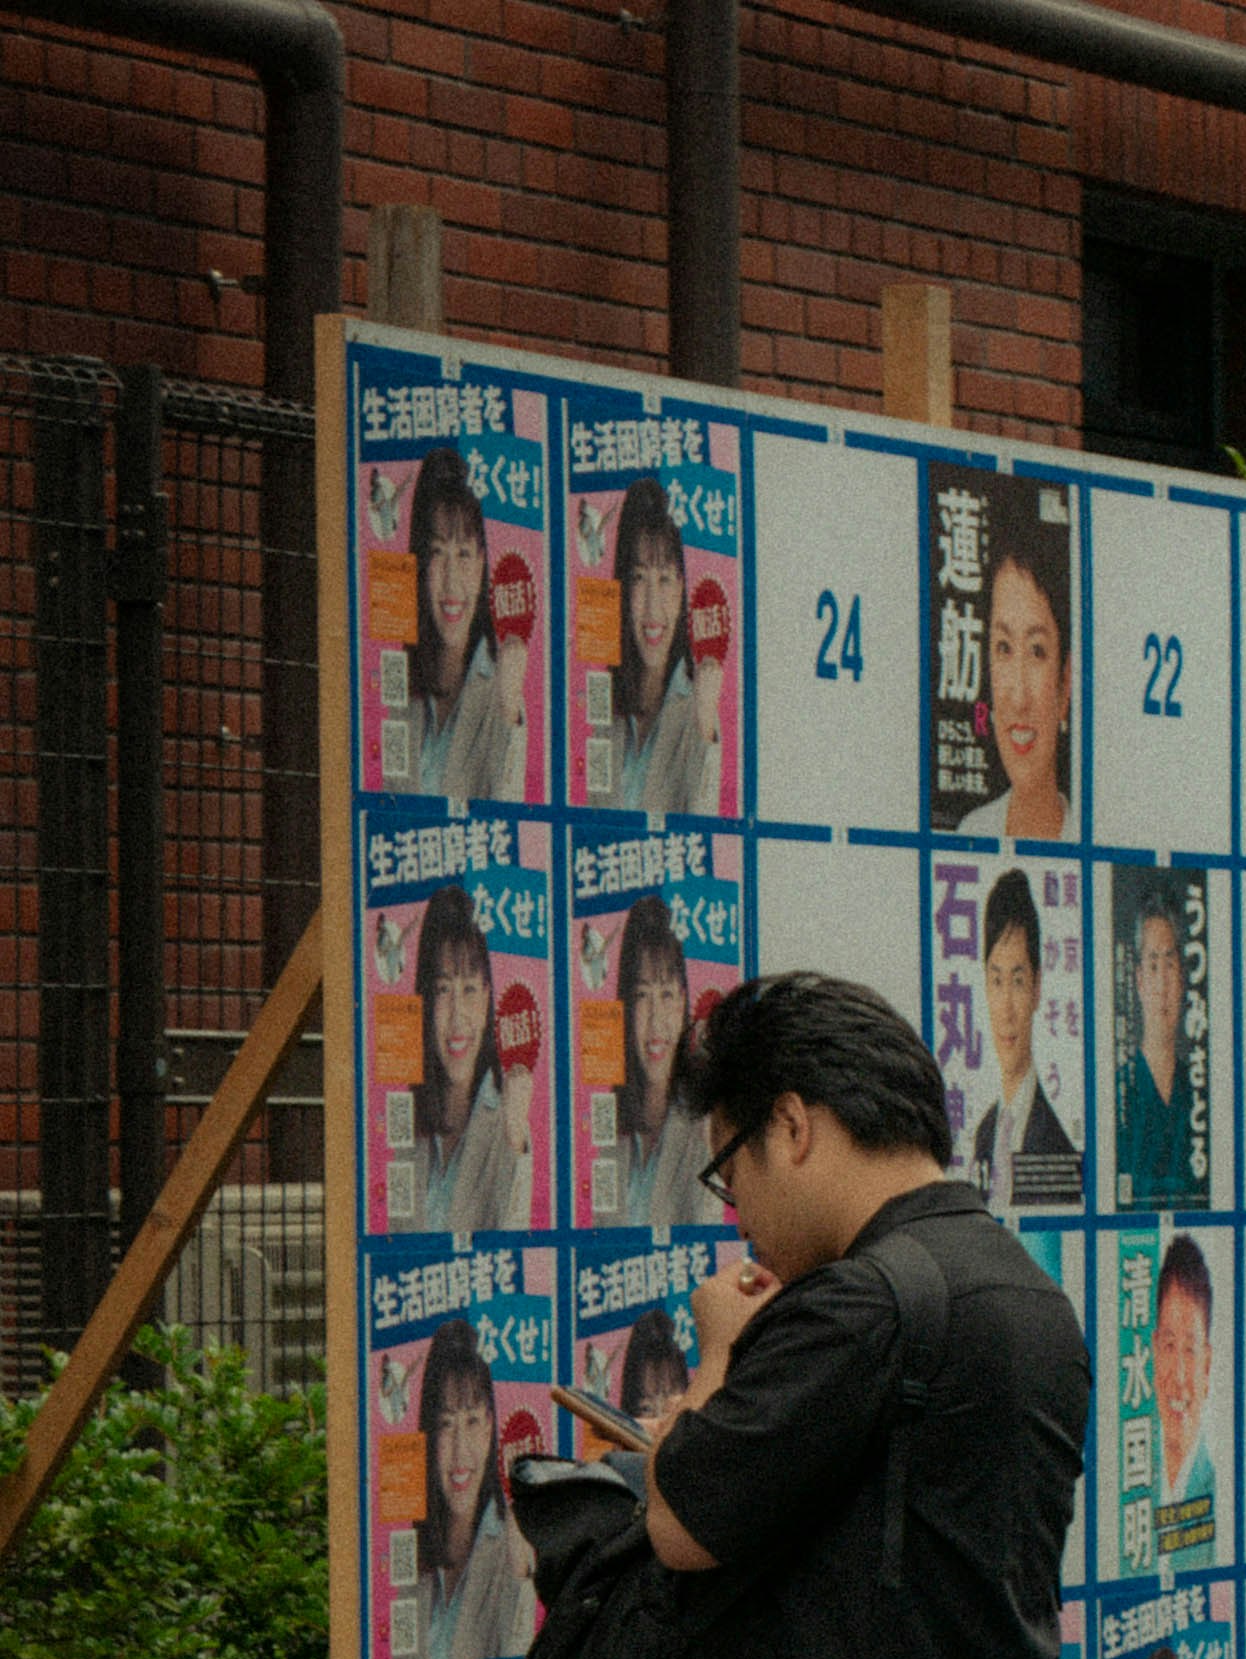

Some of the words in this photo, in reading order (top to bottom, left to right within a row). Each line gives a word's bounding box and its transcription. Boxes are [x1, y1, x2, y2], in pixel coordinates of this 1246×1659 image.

[362, 384, 507, 441] 生活困窮者を
[571, 417, 704, 474] 生活困窮者を
[815, 589, 864, 683] 24
[937, 487, 985, 702] 蓮舫
[1143, 632, 1183, 718] 22
[369, 819, 512, 888] 生活困窮者を
[574, 832, 706, 900] 生活困窮者を
[1183, 884, 1207, 1180] うつみさとる
[374, 1248, 517, 1331] 生活困窮者を
[1122, 1253, 1152, 1573] 清水国明
